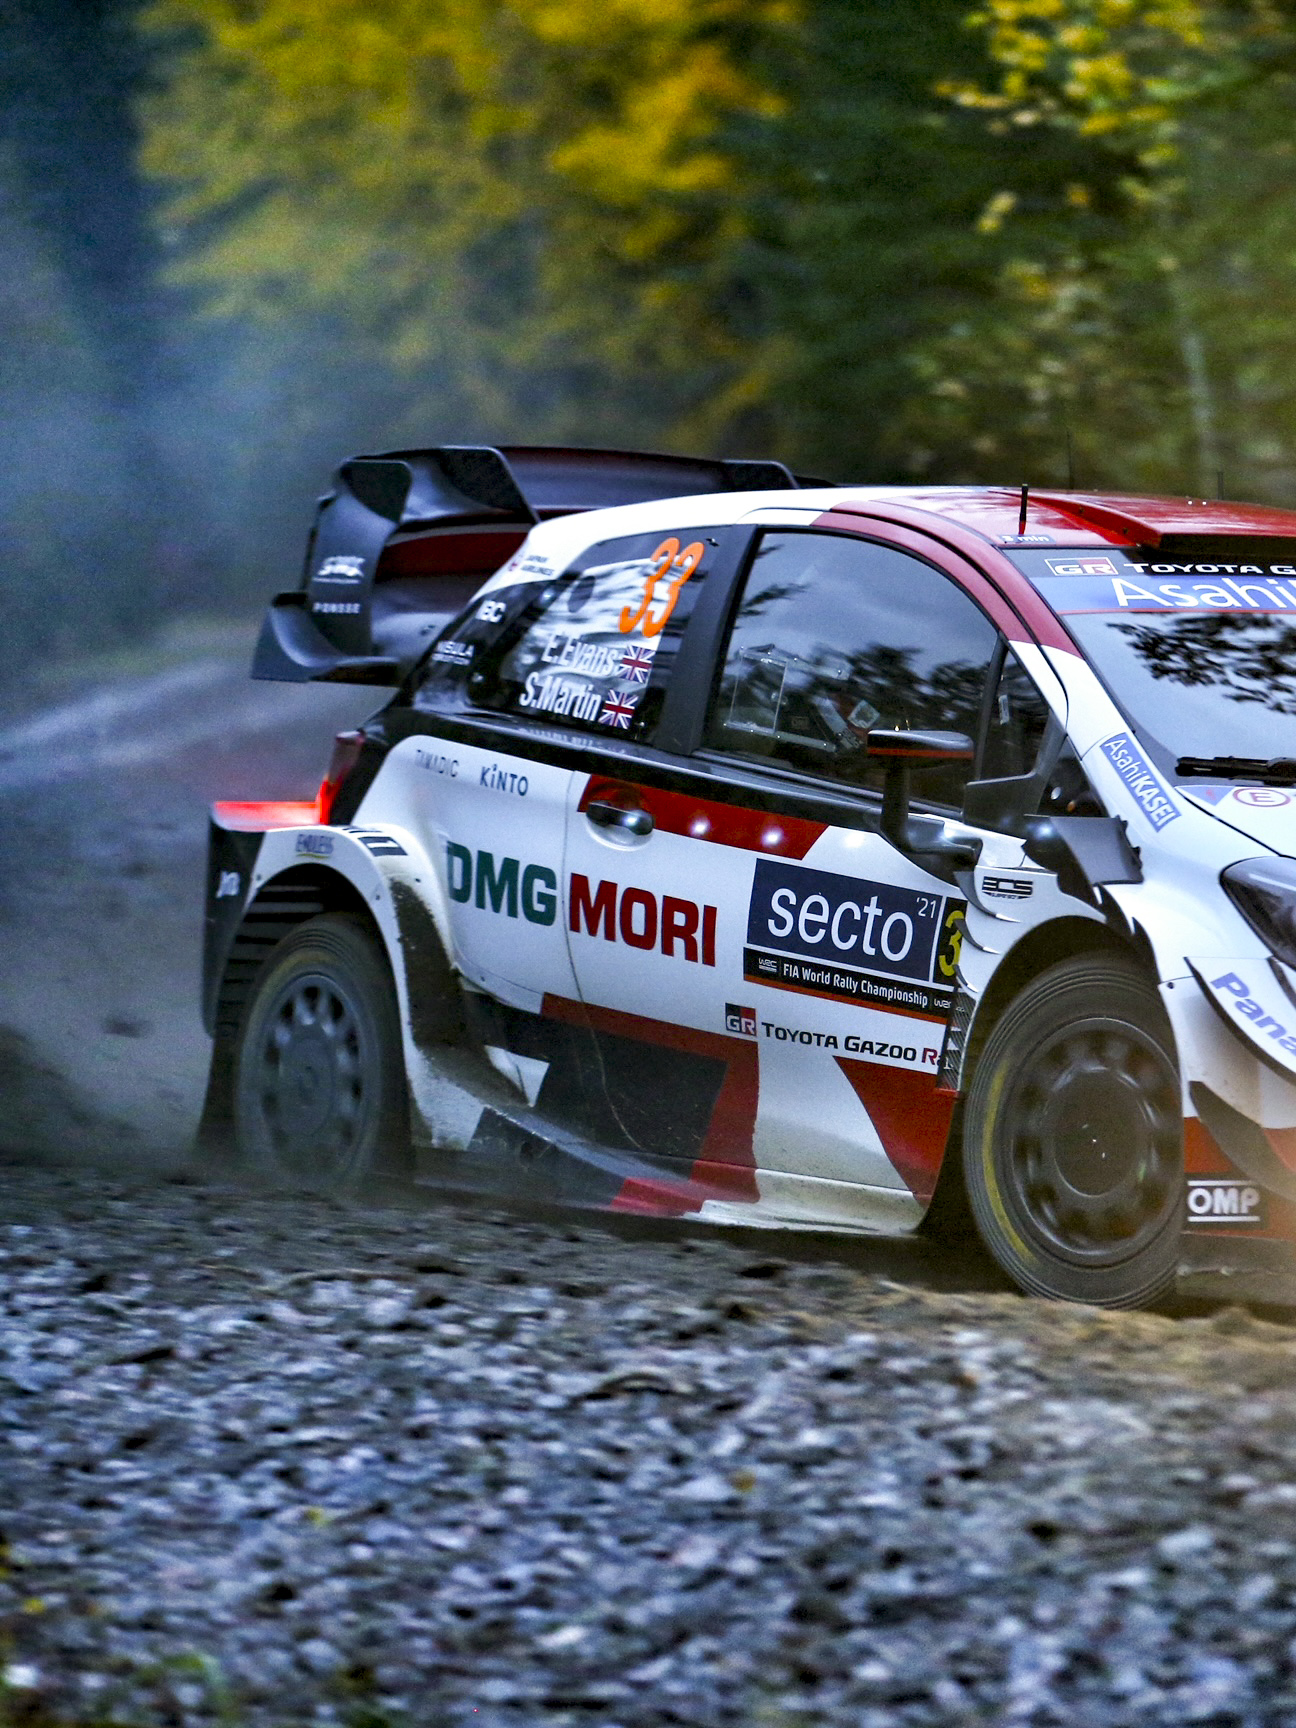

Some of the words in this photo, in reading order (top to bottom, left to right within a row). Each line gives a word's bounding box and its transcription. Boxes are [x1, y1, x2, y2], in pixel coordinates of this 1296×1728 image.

[618, 537, 705, 637] 33
[1054, 564, 1114, 574] GR
[1124, 563, 1263, 574] TOYOTA
[519, 672, 602, 721] S.Martin
[447, 840, 557, 927] DMG
[569, 872, 717, 967] MORI
[768, 887, 914, 962] secto
[783, 963, 799, 979] FIA
[802, 967, 831, 985] World
[833, 973, 859, 993] Rally
[861, 979, 928, 1009] Championship
[726, 1014, 756, 1036] GR
[761, 1021, 839, 1050] TOYOTA
[844, 1035, 917, 1062] GAZOO
[1187, 1188, 1260, 1215] OMP
